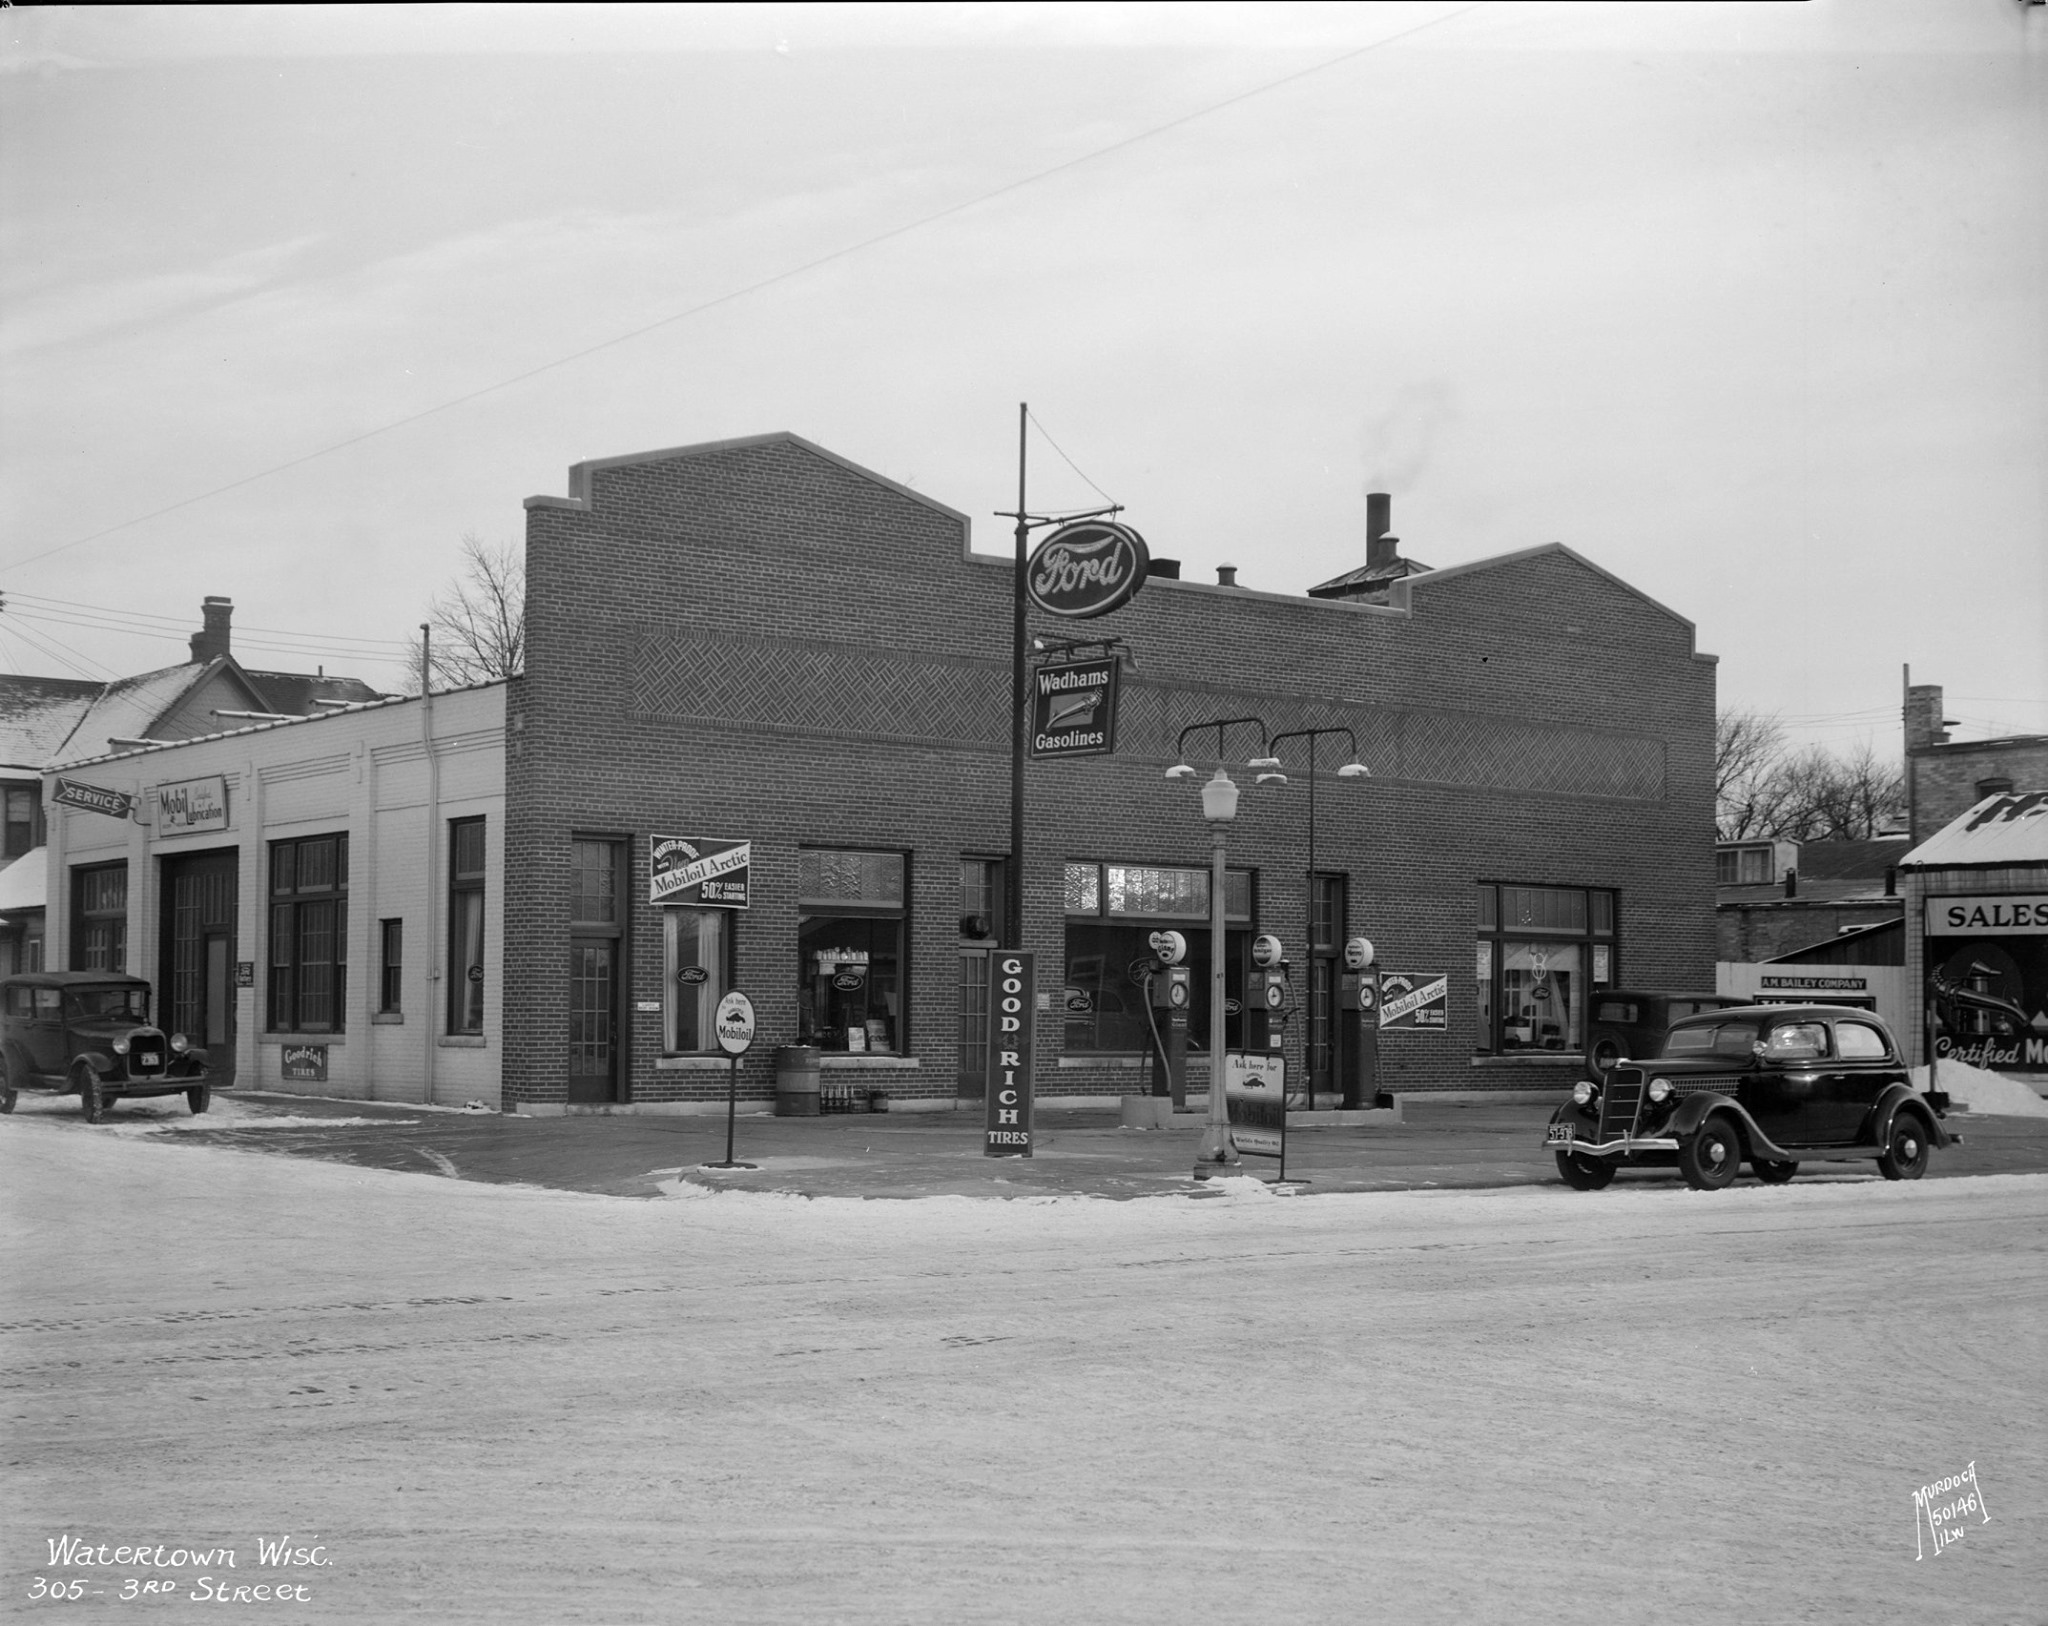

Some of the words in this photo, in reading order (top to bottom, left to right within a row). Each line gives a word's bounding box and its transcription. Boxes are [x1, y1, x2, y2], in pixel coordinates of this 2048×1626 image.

[1035, 535, 1123, 596] Ford
[1039, 670, 1109, 695] Wadhams
[1036, 731, 1104, 750] Gasolines
[66, 786, 121, 810] SERVICE
[654, 862, 708, 895] Mobiloil
[710, 851, 747, 875] Arctic
[701, 881, 724, 900] 50%
[724, 882, 745, 891] EASIER
[681, 969, 706, 981] Ford
[836, 975, 860, 987] Ford
[1781, 978, 1816, 989] BAILEY
[1818, 979, 1865, 989] COMPANY
[1382, 993, 1419, 1020] Mobiloil
[1420, 984, 1445, 1004] Arctic
[719, 1025, 752, 1041] Mobiloil
[998, 958, 1023, 1125] GOODRICH
[284, 1045, 322, 1067] Goodrich
[1934, 1035, 2020, 1070] Certified
[1232, 1059, 1247, 1070] Ask
[1248, 1060, 1264, 1071] here
[1266, 1062, 1278, 1072] for
[987, 1130, 1028, 1146] TIRES
